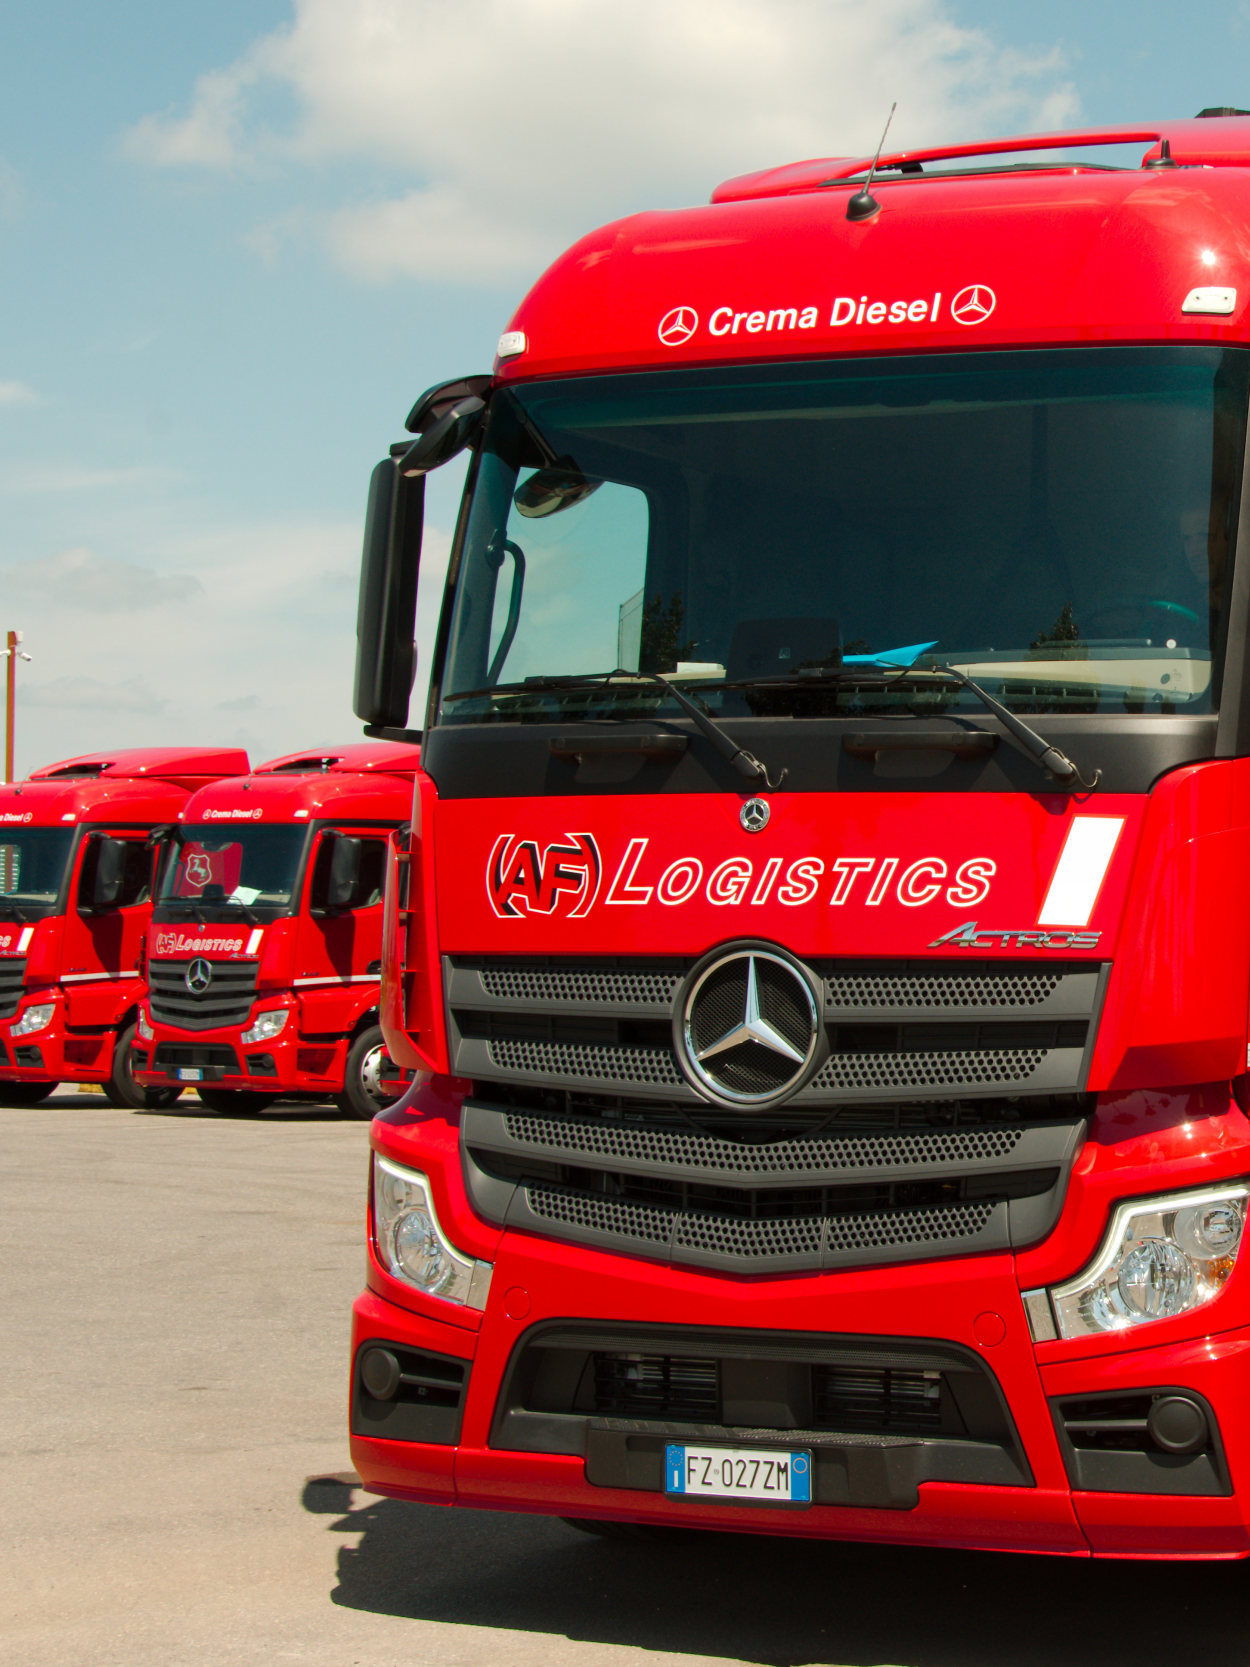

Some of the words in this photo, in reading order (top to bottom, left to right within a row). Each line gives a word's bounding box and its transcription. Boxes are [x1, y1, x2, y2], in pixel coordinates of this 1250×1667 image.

[708, 305, 818, 337] Crema
[829, 292, 942, 327] Diesel
[232, 809, 254, 818] Diesel
[604, 838, 998, 906] LOGISTICS
